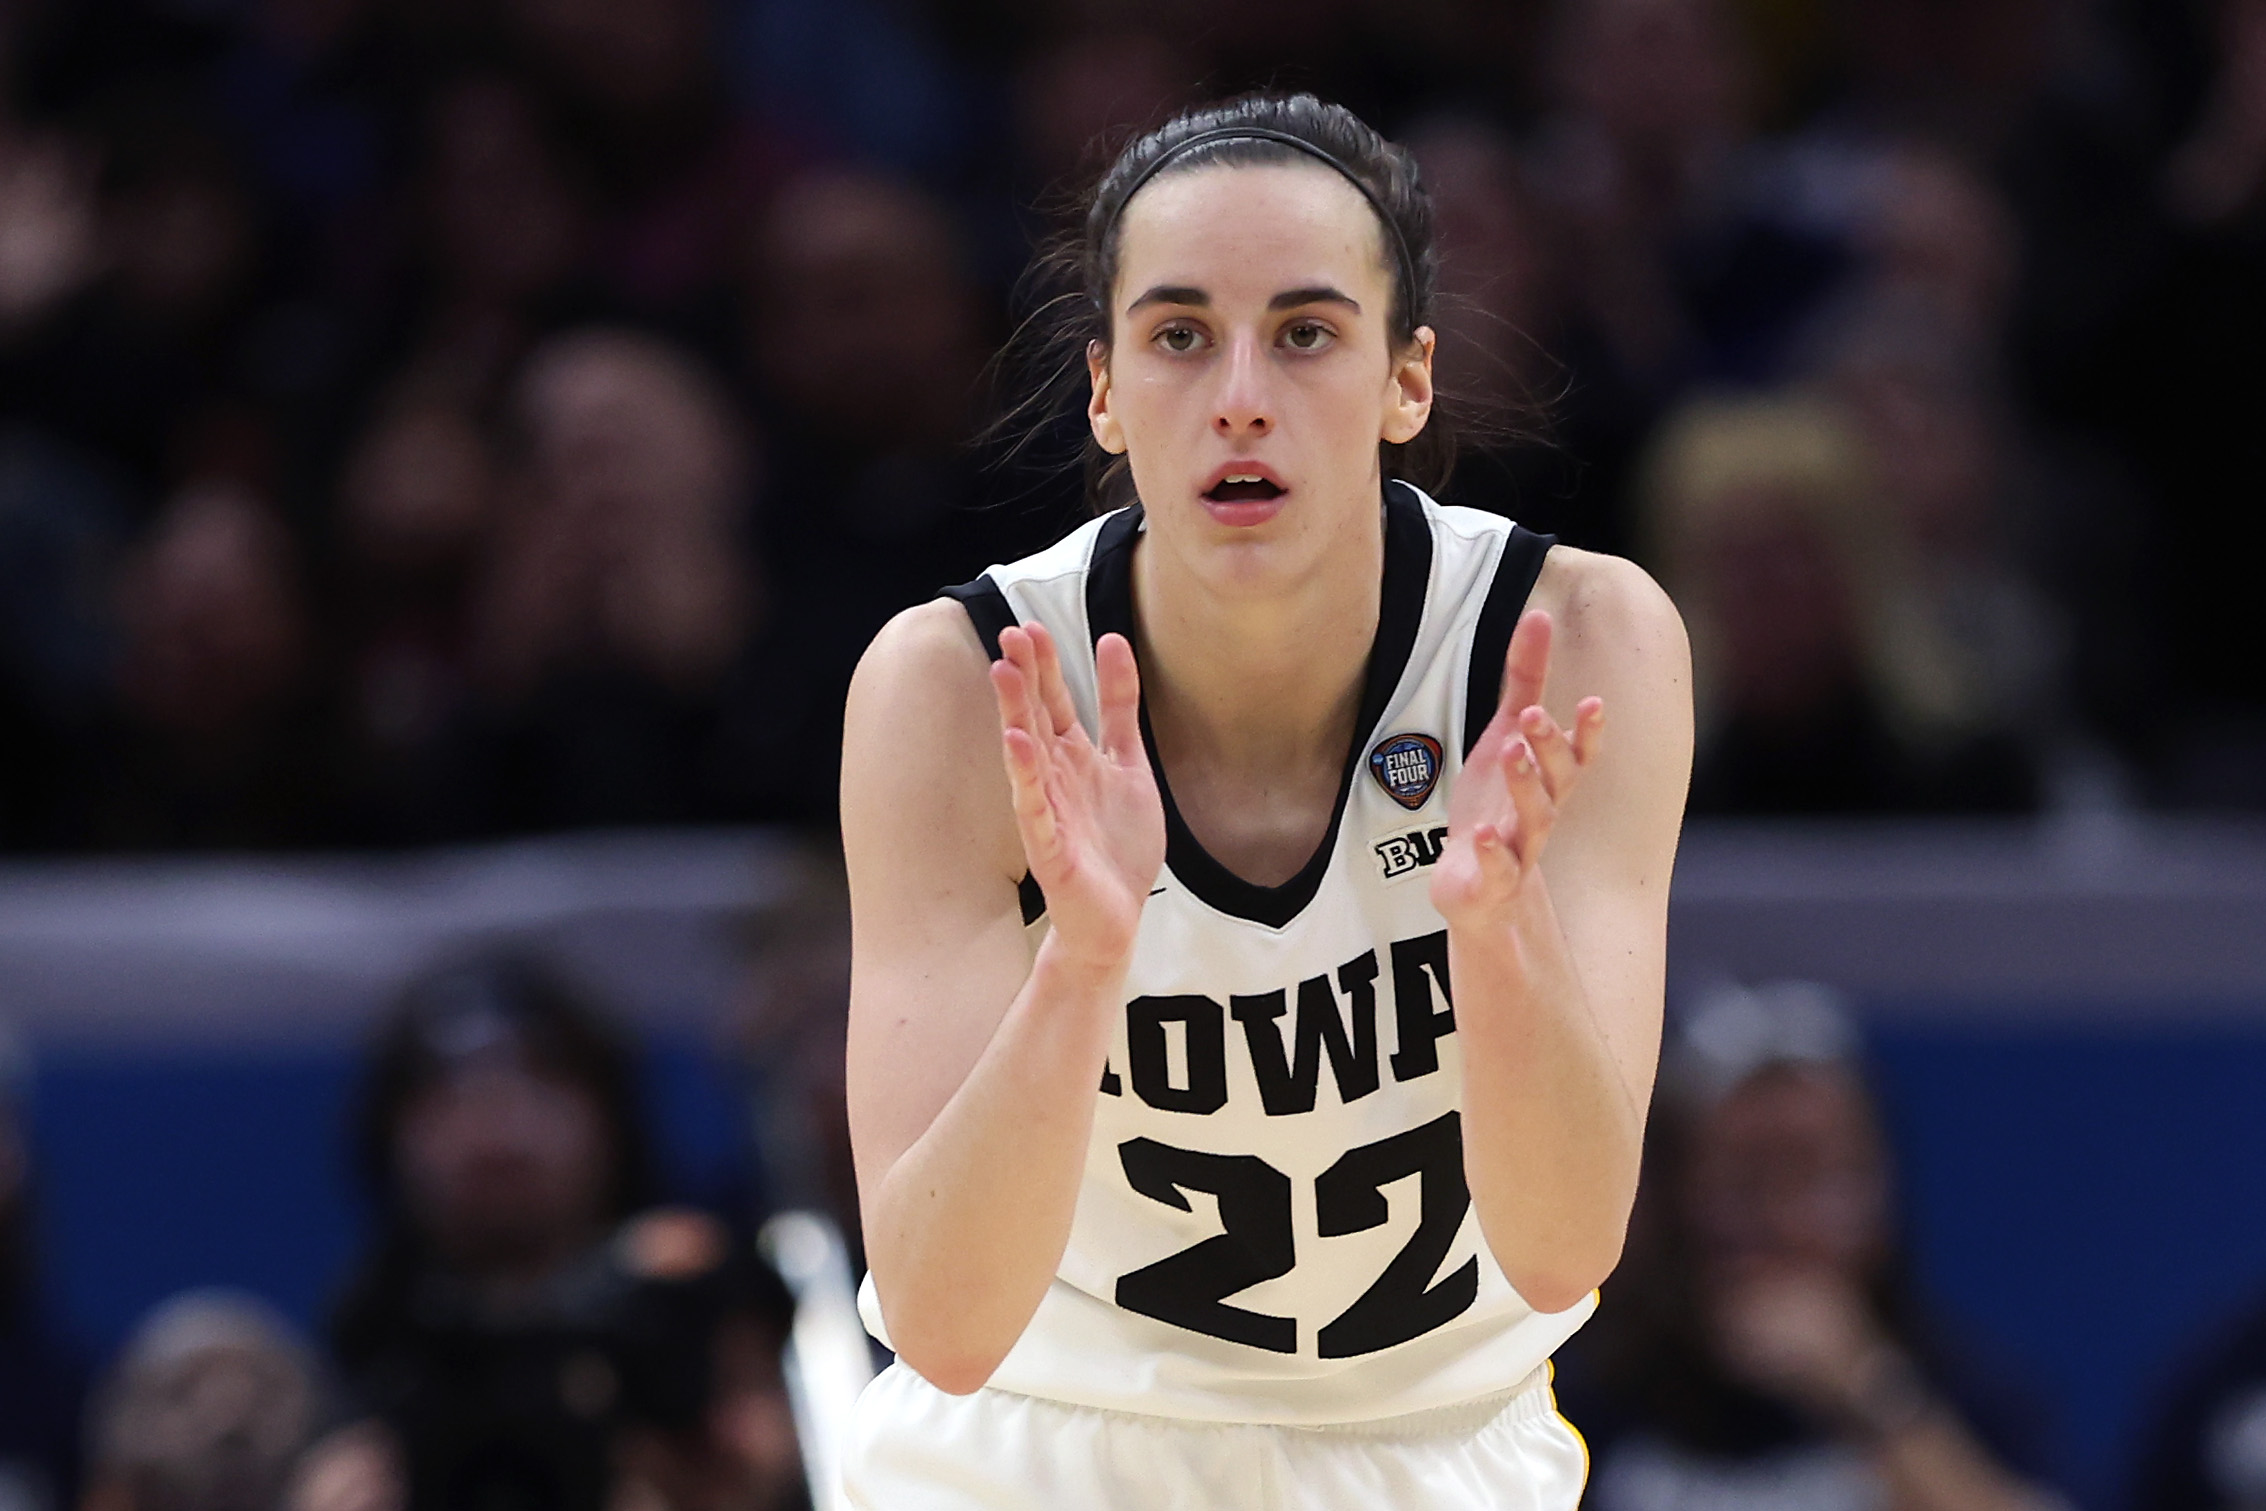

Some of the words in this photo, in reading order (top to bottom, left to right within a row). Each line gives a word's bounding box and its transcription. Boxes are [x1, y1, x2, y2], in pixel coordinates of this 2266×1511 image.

[1385, 749, 1427, 770] FINAL
[1388, 764, 1430, 787] FOUR
[1099, 929, 1457, 1116] OWA
[1115, 1110, 1479, 1359] 22
